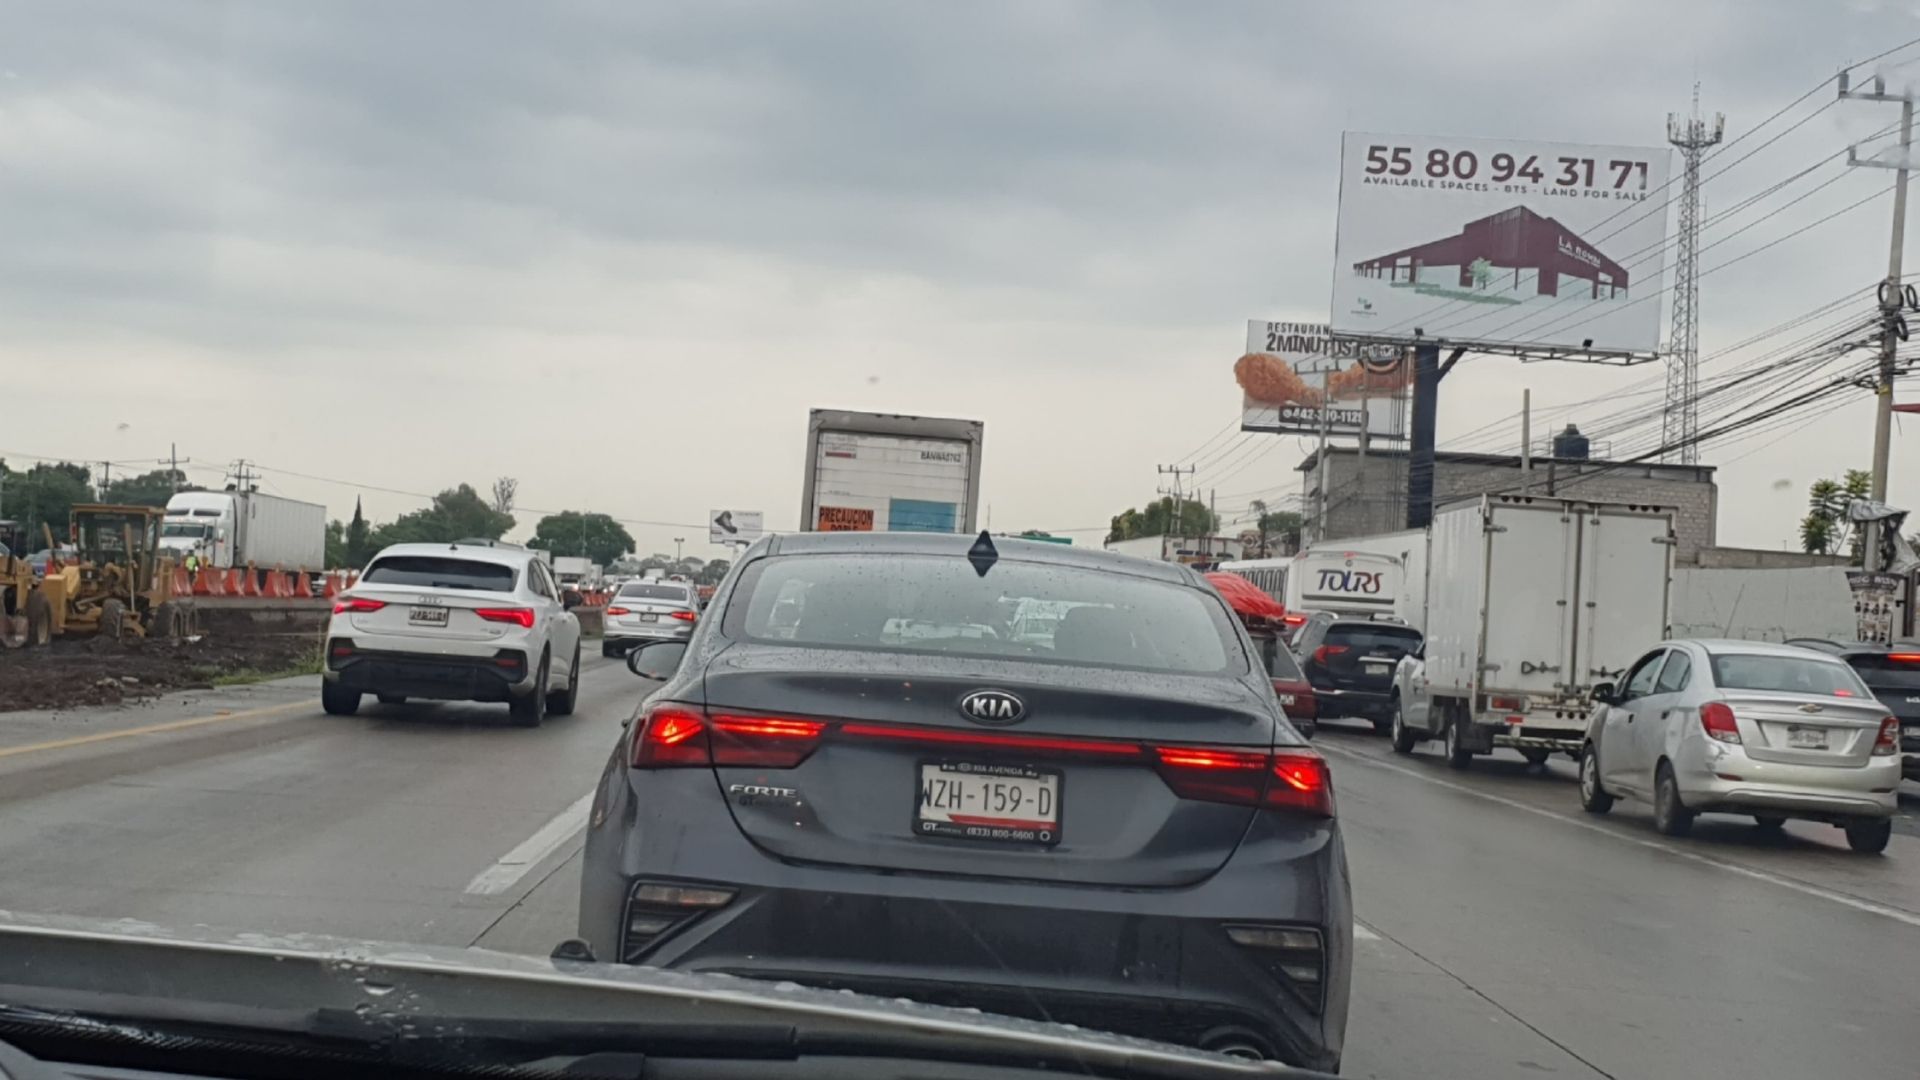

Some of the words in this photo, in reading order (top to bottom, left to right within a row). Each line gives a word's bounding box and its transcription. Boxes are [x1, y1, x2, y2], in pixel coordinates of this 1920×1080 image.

[1365, 145, 1411, 175] 55
[1425, 148, 1477, 180] 80
[1491, 152, 1544, 184] 94
[1556, 157, 1595, 187] 31
[1609, 160, 1648, 190] 71
[1364, 176, 1434, 188] AVAILABLE
[1440, 180, 1488, 192] SPACES
[1543, 187, 1578, 197] LAND
[1584, 189, 1609, 198] FOR
[1615, 191, 1647, 201] SALE
[819, 507, 874, 523] PRECAUCION
[1317, 569, 1384, 594] TOURS
[972, 697, 1014, 718] KIA
[730, 784, 796, 798] FORTE
